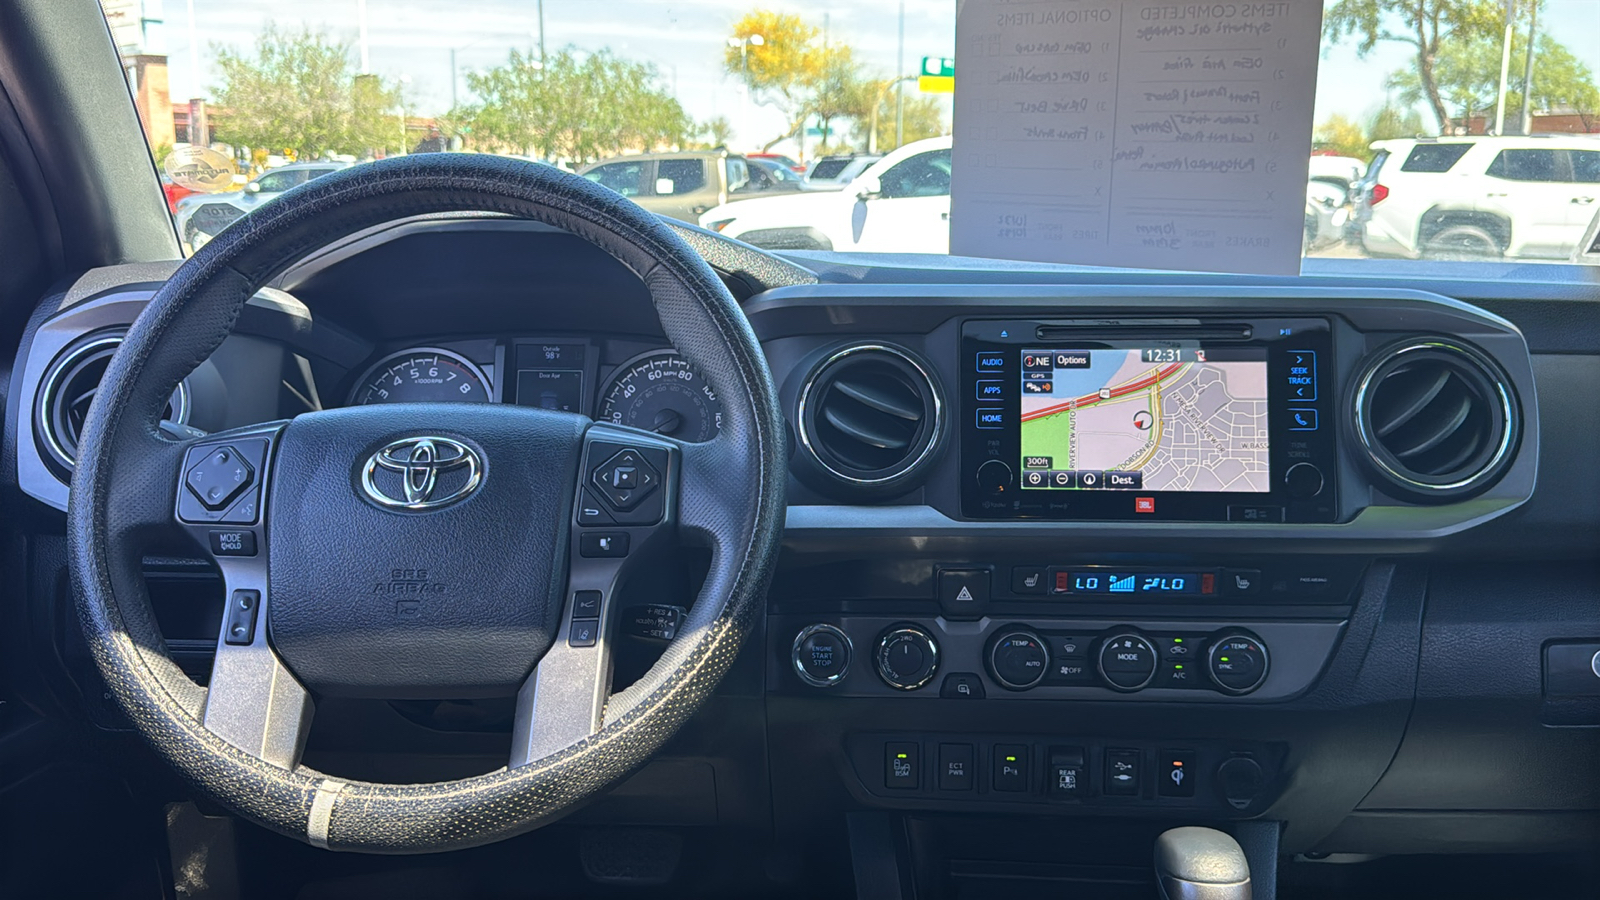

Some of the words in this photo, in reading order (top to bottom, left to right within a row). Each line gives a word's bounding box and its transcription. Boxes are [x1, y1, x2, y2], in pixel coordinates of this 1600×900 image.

[1057, 355, 1087, 366] Options
[1147, 349, 1181, 362] 12:31
[982, 359, 1004, 367] AUDIO
[1036, 357, 1050, 366] NE
[410, 368, 420, 379] 5
[428, 367, 439, 378] 6
[446, 371, 458, 382] 7
[648, 370, 663, 381] 60
[678, 370, 693, 382] 80
[1291, 367, 1309, 375] SEEK
[393, 376, 403, 387] 4
[1288, 377, 1312, 385] TRACK
[378, 388, 389, 400] 3
[459, 383, 472, 394] 8
[623, 384, 637, 399] 40
[984, 386, 1002, 395] APPS
[982, 415, 1003, 423] HOME
[1069, 411, 1077, 431] AUTO
[1189, 411, 1220, 446] RIVERVIEW
[1216, 442, 1226, 454] DR
[1069, 433, 1077, 469] RIVERVIEW
[1121, 448, 1146, 471] DOBSON
[1144, 440, 1155, 450] RD
[1111, 476, 1135, 485] Dest.
[1139, 501, 1152, 509] JBL
[220, 533, 242, 543] MODE
[372, 583, 448, 595] AIRBAG
[1075, 577, 1099, 590] LO
[1161, 578, 1185, 591] LO
[1012, 640, 1029, 648] TEMP
[812, 652, 834, 660] START
[813, 659, 832, 667] STOP
[1069, 667, 1082, 675] OFF
[1173, 672, 1186, 680] A/C
[895, 769, 910, 777] BSM
[949, 769, 964, 777] PWR
